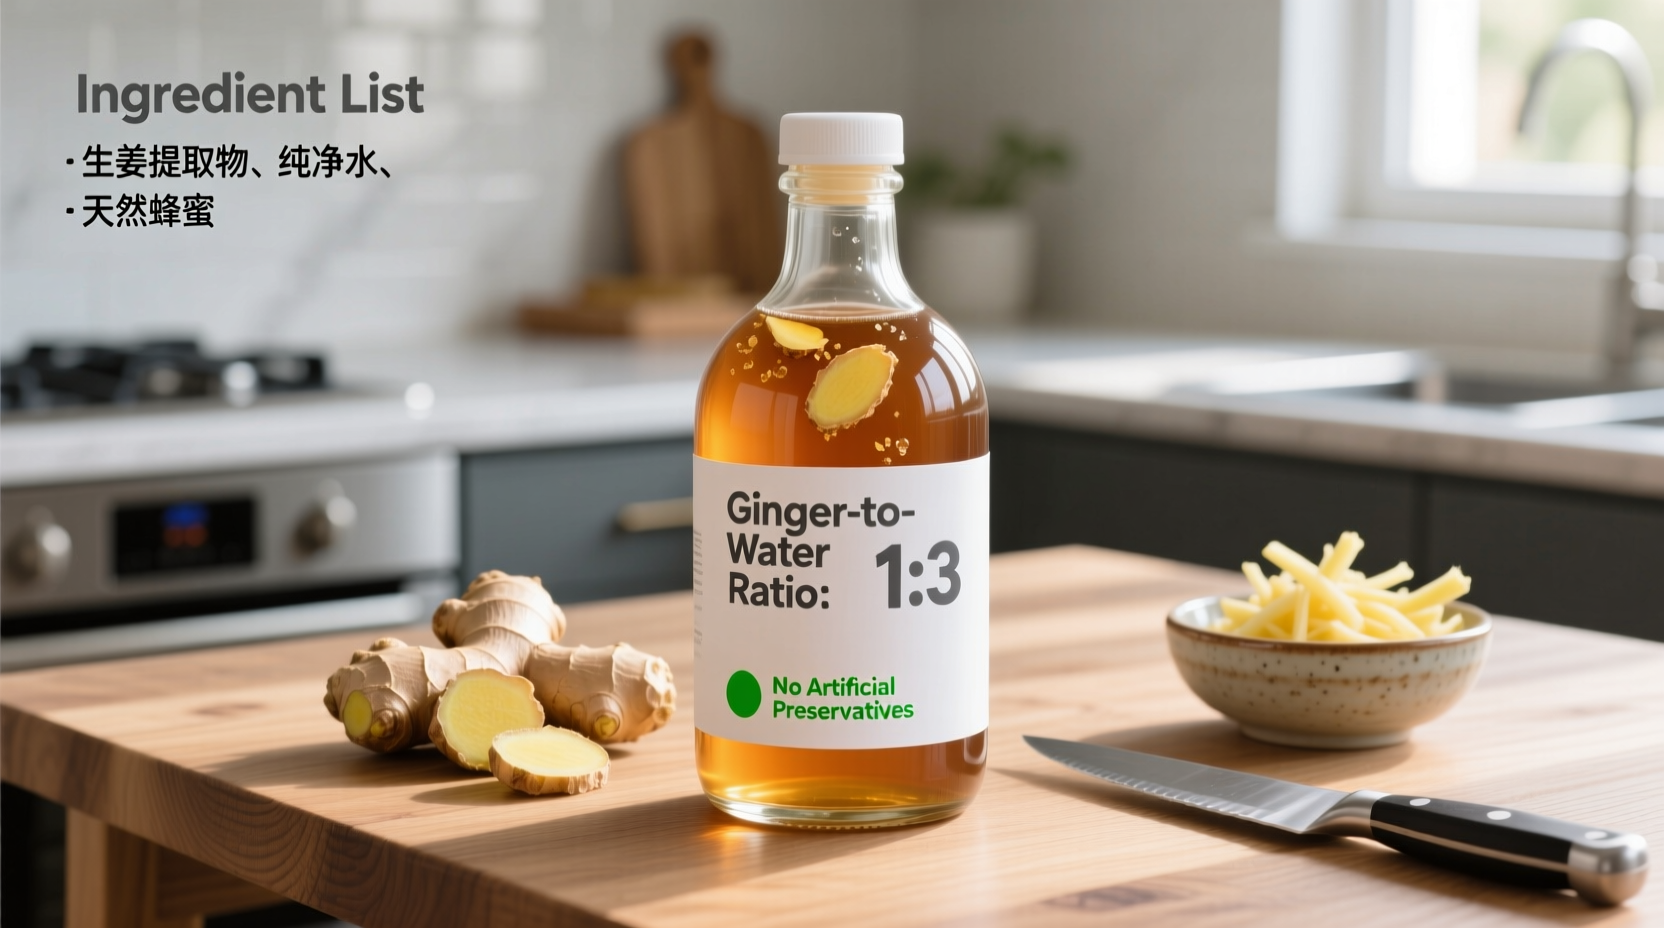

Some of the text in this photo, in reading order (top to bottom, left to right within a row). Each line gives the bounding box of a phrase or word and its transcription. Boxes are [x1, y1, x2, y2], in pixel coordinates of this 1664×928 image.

[726, 490, 916, 537] Ginger-to-
[726, 531, 831, 569] Water
[728, 571, 830, 610] Ratio:
[875, 540, 962, 610] 1:3
[772, 676, 895, 697] No Artificial
[772, 700, 915, 721] Preservatives
